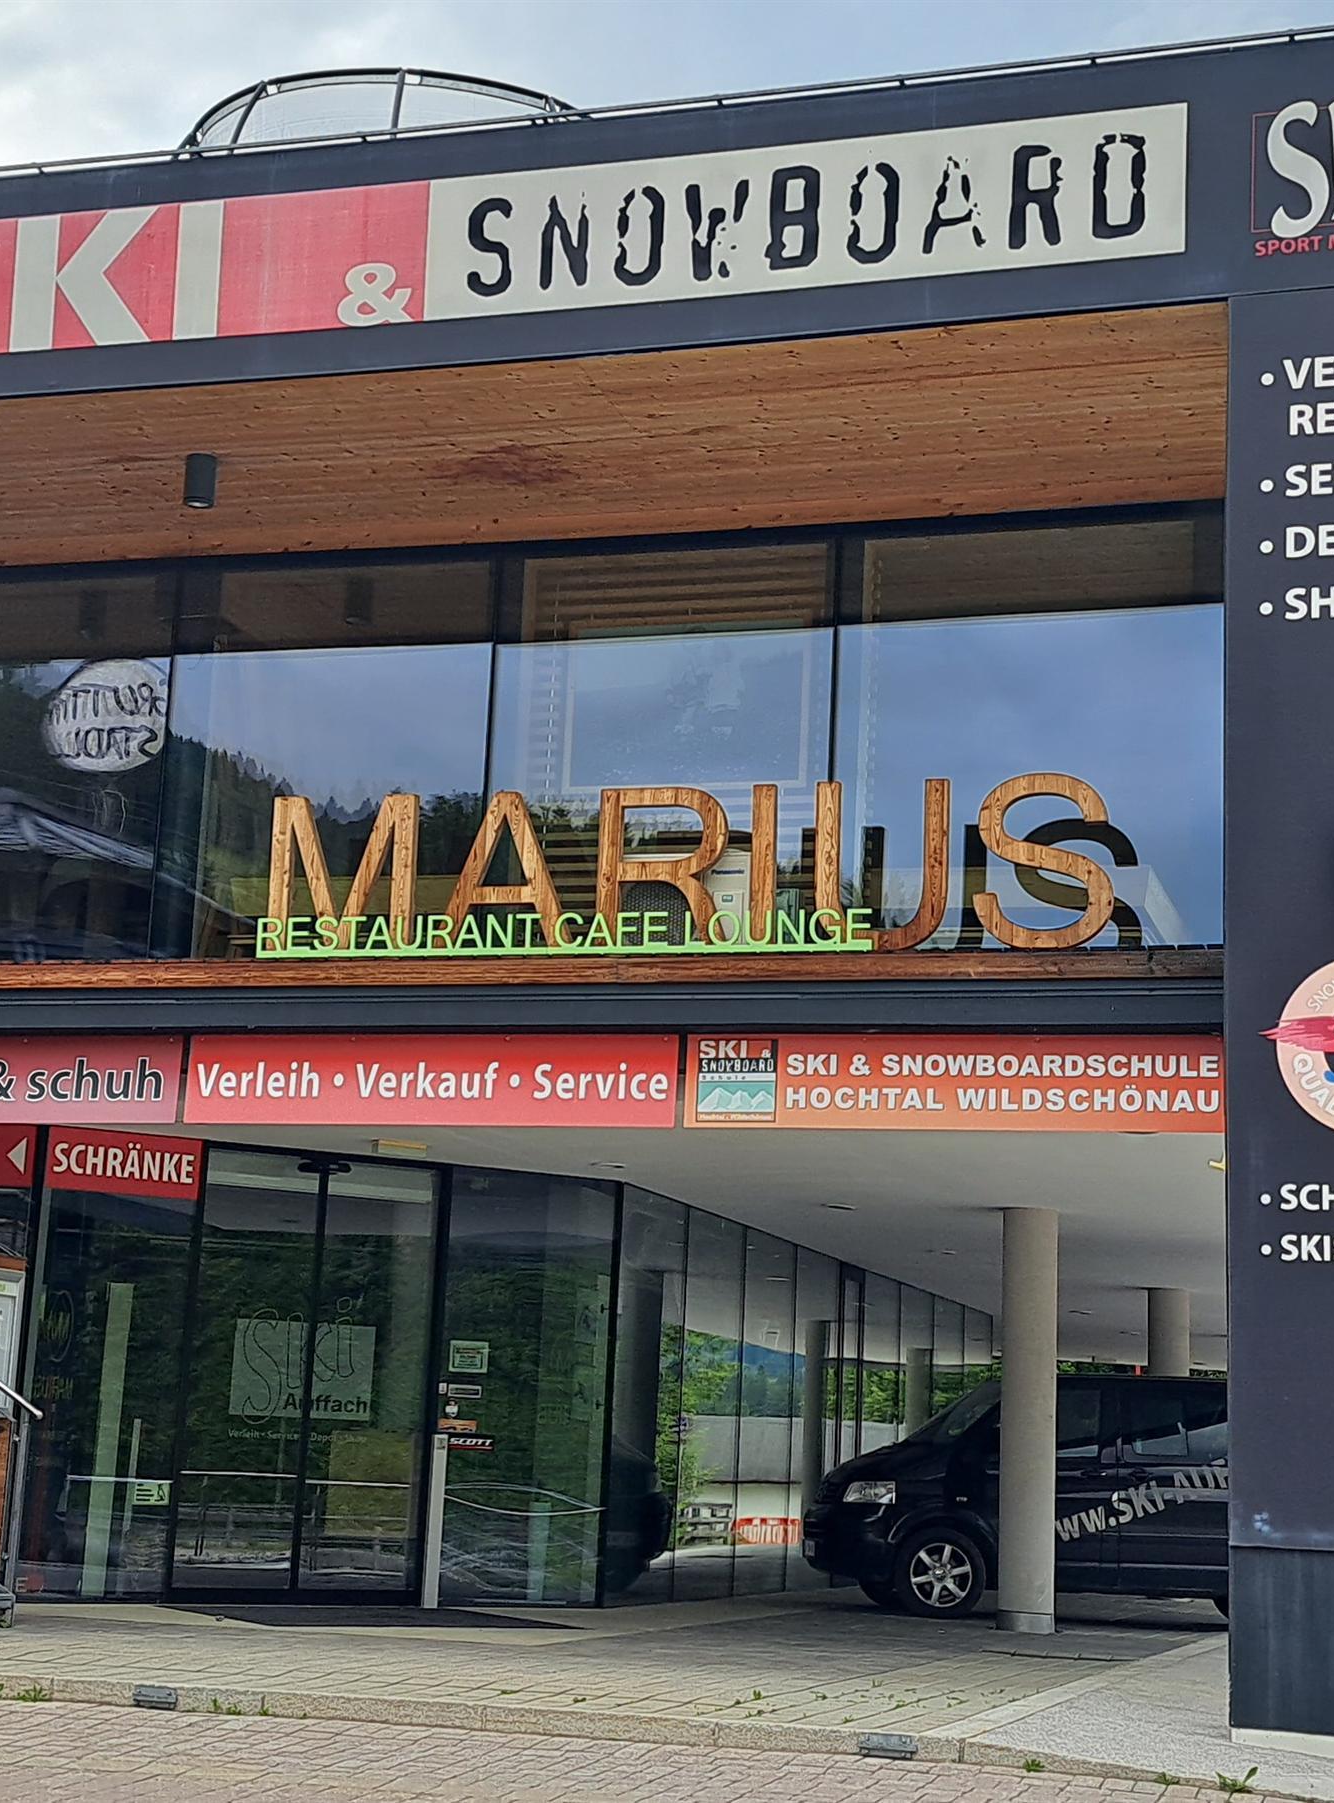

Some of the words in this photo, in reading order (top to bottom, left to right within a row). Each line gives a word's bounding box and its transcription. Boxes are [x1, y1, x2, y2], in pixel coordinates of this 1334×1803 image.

[337, 262, 413, 328] &
[466, 131, 1147, 297] SNOWBOARD
[1254, 234, 1323, 257] SPORT
[267, 770, 1114, 950] MARIUS
[256, 912, 542, 950] RESTAURANT
[553, 910, 669, 949] CAFE
[684, 907, 874, 948] LOUNGE
[699, 1040, 748, 1059] SKI
[760, 1048, 772, 1059] &
[701, 1058, 775, 1073] SNOWBOARD
[785, 1054, 838, 1077] SKI
[849, 1054, 872, 1077] &
[881, 1053, 1221, 1079] SNOWBOARDSCHULE
[24, 1056, 164, 1103] schuh
[197, 1060, 320, 1099] Verleih
[356, 1060, 499, 1100] Verkauf
[533, 1063, 669, 1101] Service
[785, 1086, 944, 1112] HOCHTAL
[957, 1083, 1221, 1113] WILDSCHÖNAU
[51, 1141, 196, 1185] SCHRÄNKE
[448, 1437, 494, 1447] SCOTT
